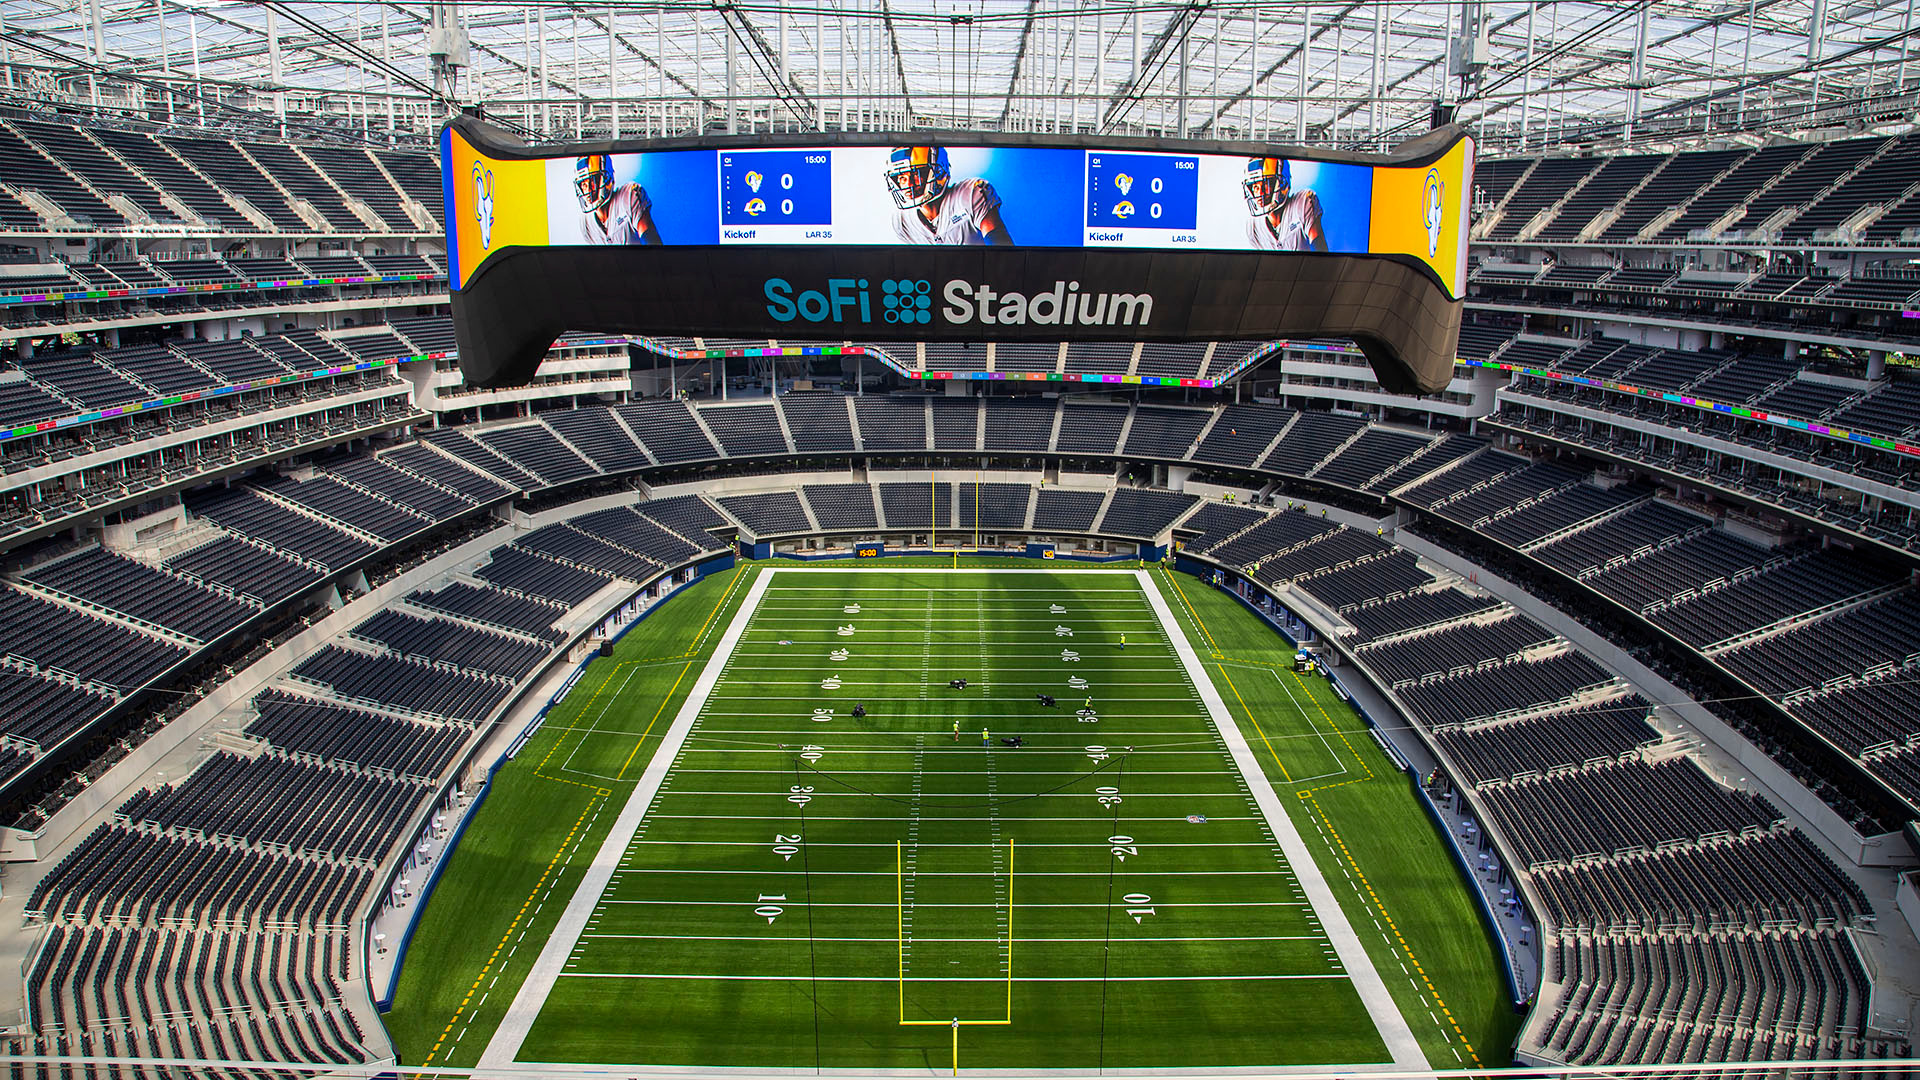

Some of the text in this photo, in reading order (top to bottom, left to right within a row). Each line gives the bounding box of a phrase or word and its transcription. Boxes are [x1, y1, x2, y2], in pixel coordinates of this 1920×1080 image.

[804, 155, 826, 164] 15:00
[1174, 161, 1195, 170] 15:00
[780, 173, 793, 189] 0
[1150, 177, 1163, 193] 0
[781, 199, 794, 215] 0
[1150, 202, 1162, 219] 0
[724, 230, 756, 239] Kickoff
[805, 231, 832, 239] LAR 35
[1089, 232, 1123, 241] Kickoff
[1172, 235, 1197, 243] LAR 35
[763, 277, 1153, 326] SoFi Stadium
[859, 549, 877, 557] 15:00
[821, 677, 842, 690] 40
[1067, 678, 1089, 690] 40
[811, 708, 834, 722] 50
[1076, 709, 1098, 723] 50
[800, 744, 825, 759] 40
[1085, 745, 1110, 760] 40
[787, 785, 815, 803] 30
[1096, 786, 1122, 804] 30
[772, 834, 802, 855] 20
[1107, 835, 1138, 856] 20
[754, 893, 787, 917] 10
[1123, 893, 1156, 917] 10
